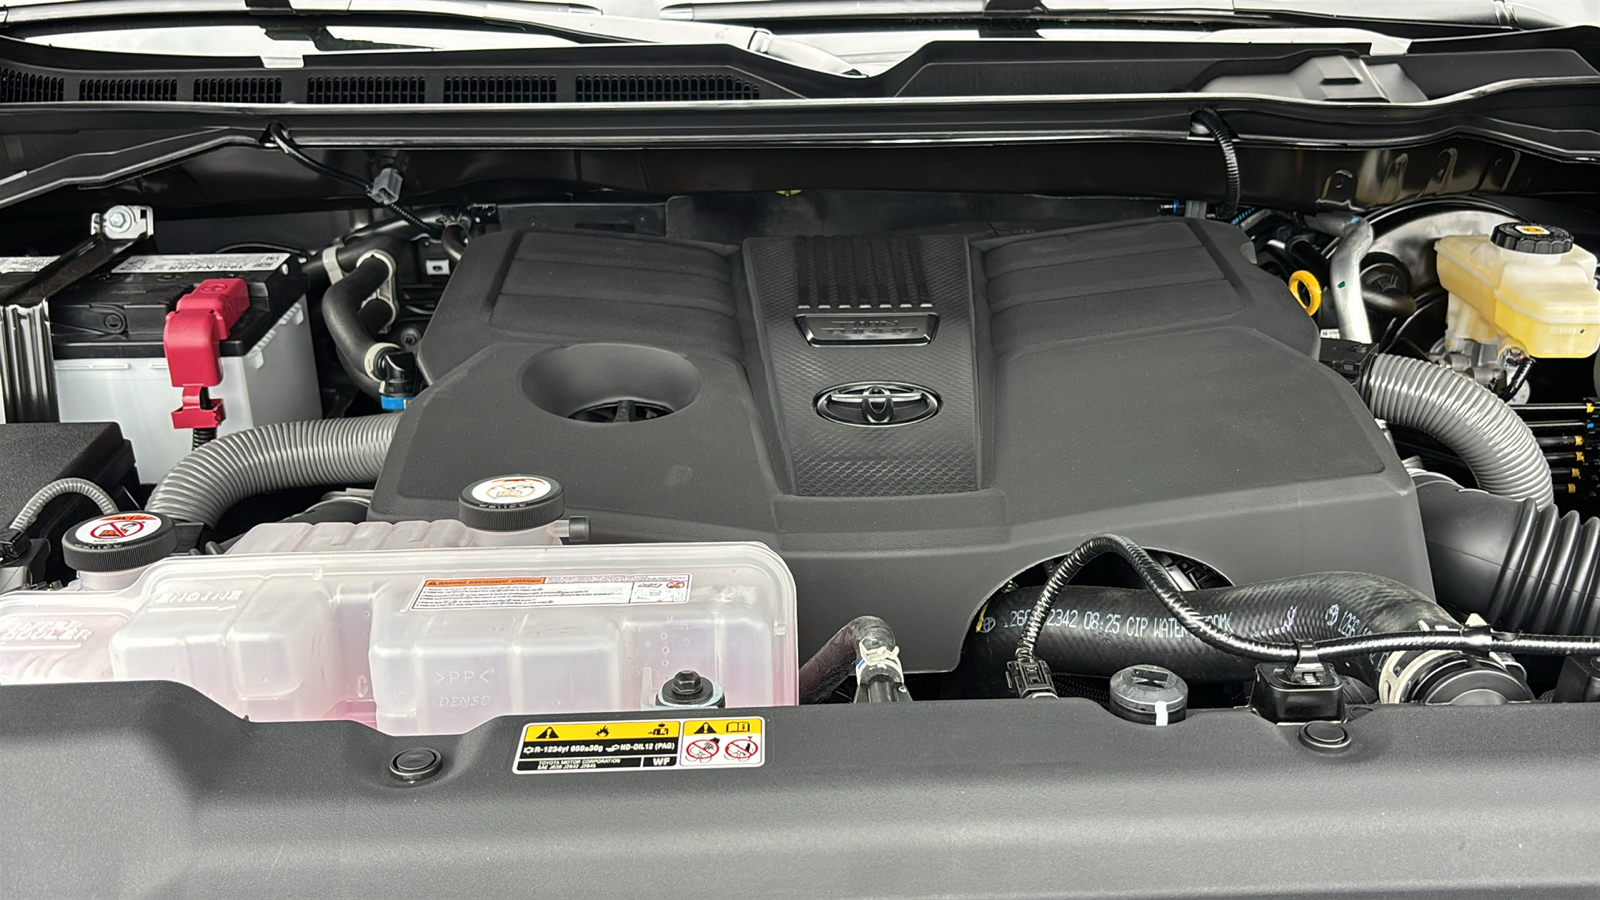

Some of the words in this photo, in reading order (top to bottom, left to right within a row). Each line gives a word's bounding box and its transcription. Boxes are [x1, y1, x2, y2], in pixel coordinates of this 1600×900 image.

[155, 590, 244, 604] ENGINE
[1083, 611, 1122, 634] 08:25
[1126, 616, 1149, 638] CIP
[438, 695, 492, 707] DENSO
[655, 742, 675, 750] (PAG)
[653, 757, 671, 766] WF
